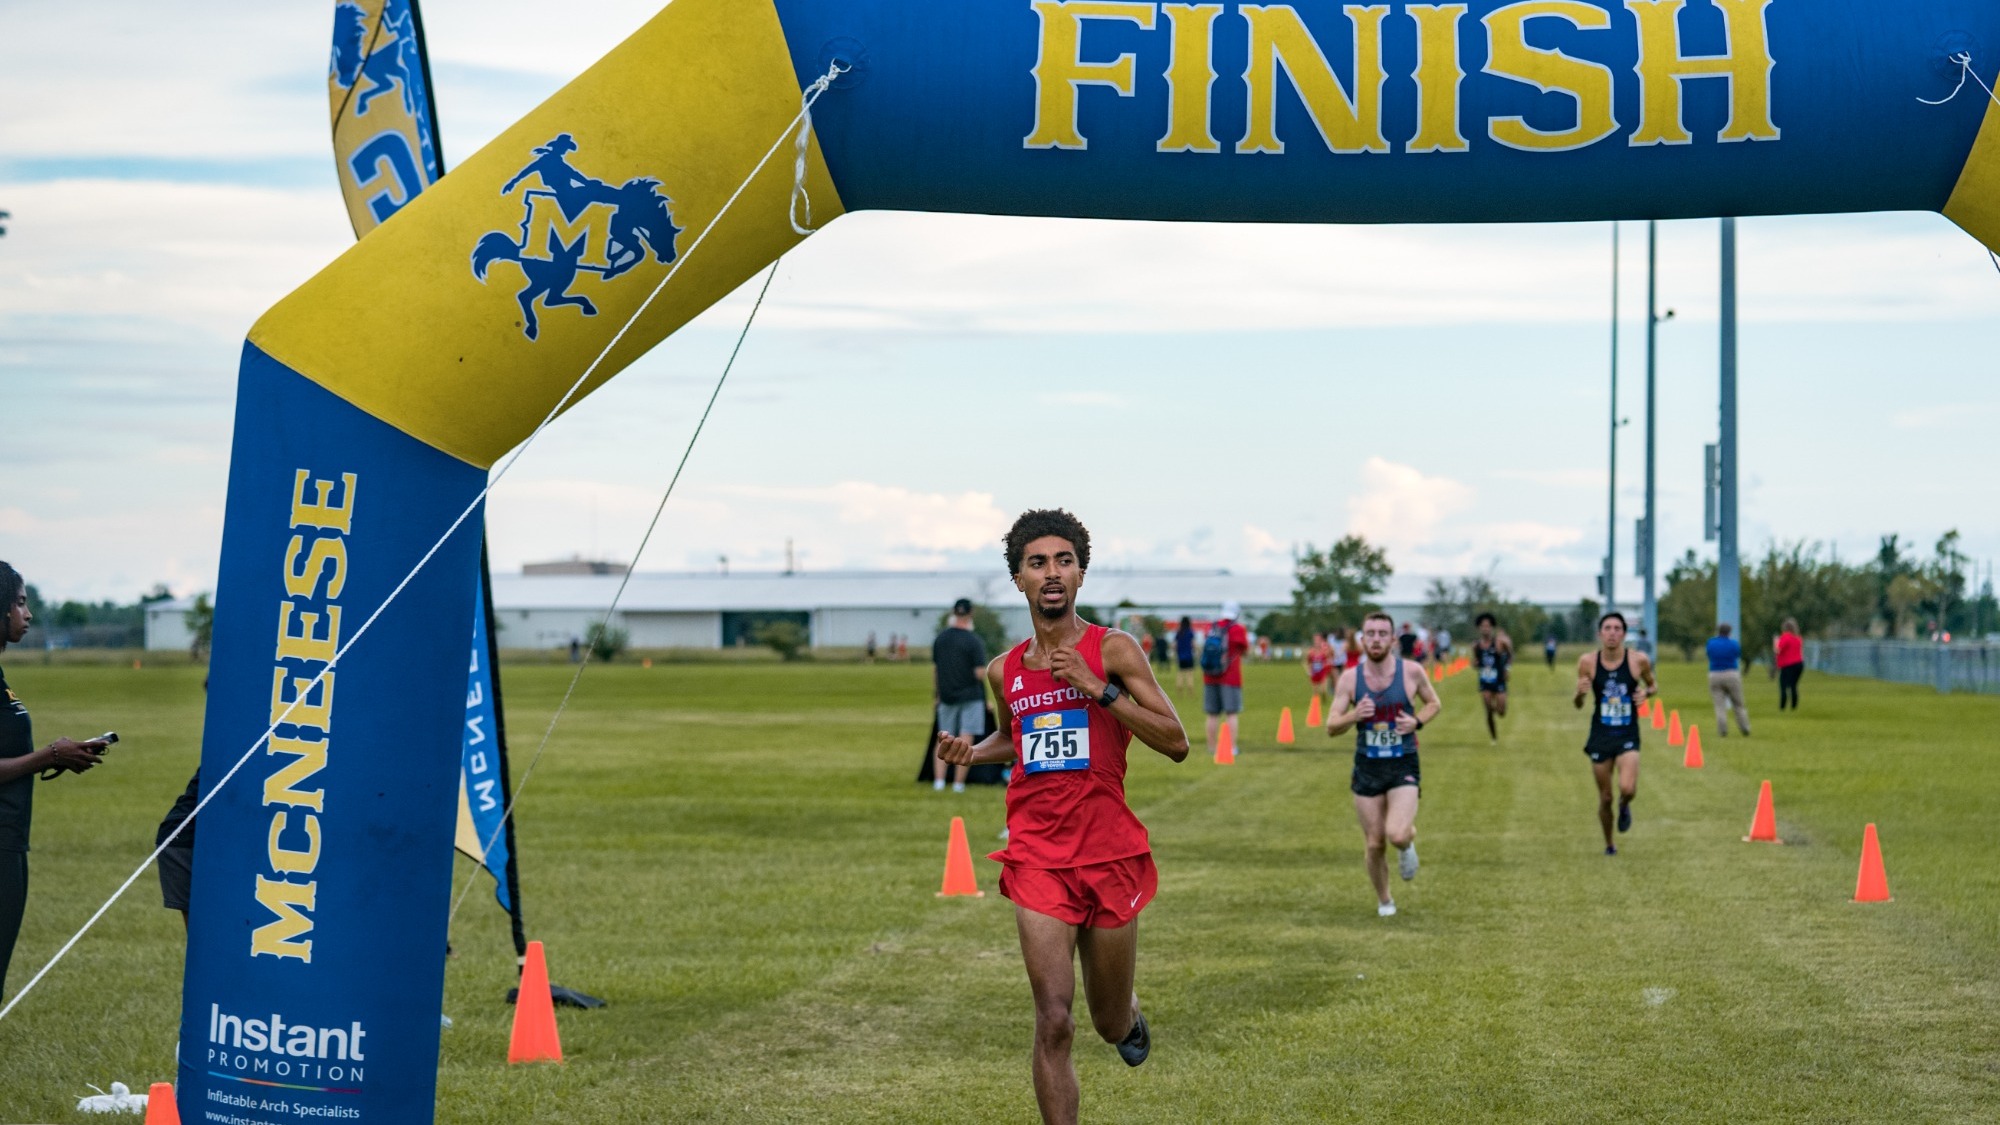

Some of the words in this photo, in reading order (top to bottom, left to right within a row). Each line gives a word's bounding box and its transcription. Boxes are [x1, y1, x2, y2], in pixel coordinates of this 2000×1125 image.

[1023, 0, 1781, 155] FINISH
[250, 468, 358, 964] MCNEESE
[1029, 730, 1078, 760] 755
[1372, 732, 1397, 746] 765
[209, 1002, 366, 1061] Instant
[208, 1048, 364, 1082] PROMOTION
[207, 1088, 257, 1108] Inflatable
[259, 1099, 289, 1113] Arch
[292, 1103, 360, 1118] Specialists
